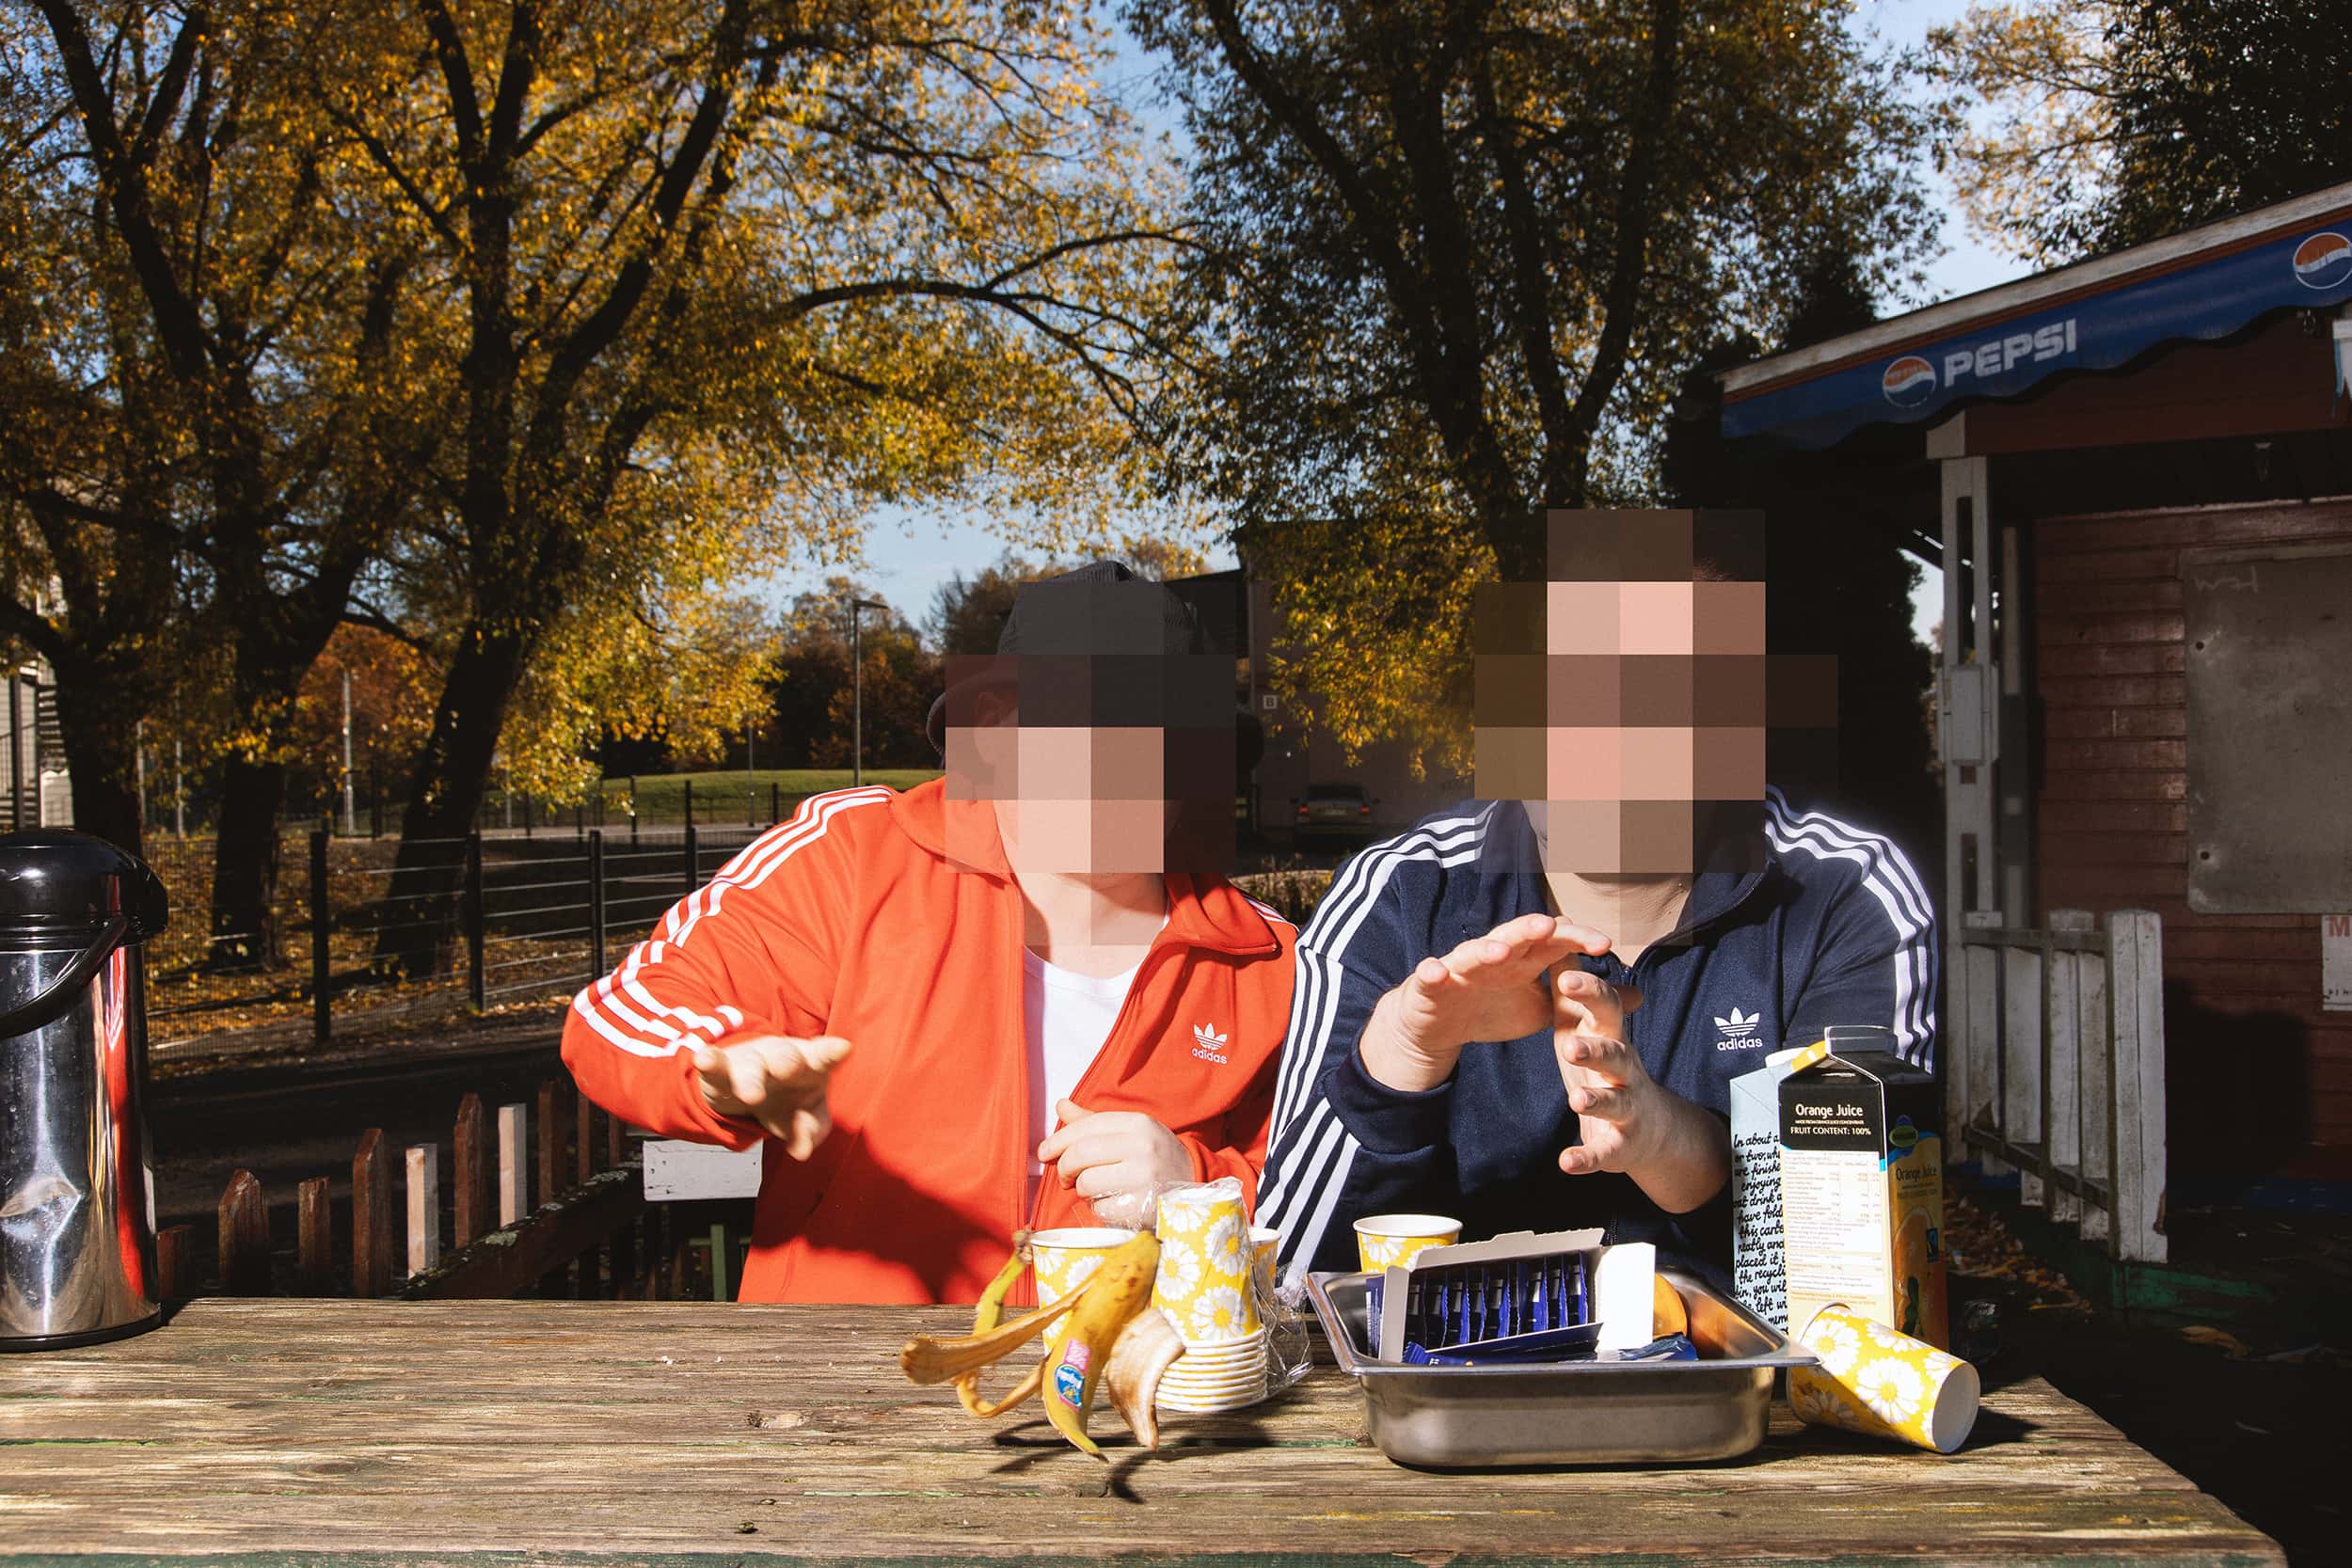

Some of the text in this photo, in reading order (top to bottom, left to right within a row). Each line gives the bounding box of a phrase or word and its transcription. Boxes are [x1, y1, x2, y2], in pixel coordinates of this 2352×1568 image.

[1944, 318, 2077, 388] PEPSI
[1717, 1037, 1763, 1051] adidas
[1191, 1047, 1228, 1065] adidas
[1795, 1102, 1864, 1119] Orange Juice
[1734, 1133, 1744, 1148] In
[1746, 1132, 1772, 1146] about
[1790, 1126, 1871, 1135] FRUIT CONTENT: 100%
[1751, 1160, 1781, 1180] finishe
[1896, 1167, 1920, 1182] Orange
[1741, 1175, 1781, 1196] enjoying
[1750, 1189, 1775, 1207] drink
[1777, 1193, 1783, 1201] a
[1738, 1203, 1783, 1224] have fold
[1739, 1223, 1758, 1239] this
[1760, 1219, 1784, 1236] carto
[1738, 1237, 1766, 1257] neatly
[1736, 1254, 1767, 1274] placed
[1770, 1251, 1779, 1265] it
[1739, 1269, 1753, 1285] the
[1755, 1263, 1786, 1285] recycli
[1753, 1285, 1769, 1300] you
[1771, 1279, 1787, 1293] wil
[1756, 1296, 1773, 1315] left
[1777, 1295, 1788, 1309] wi
